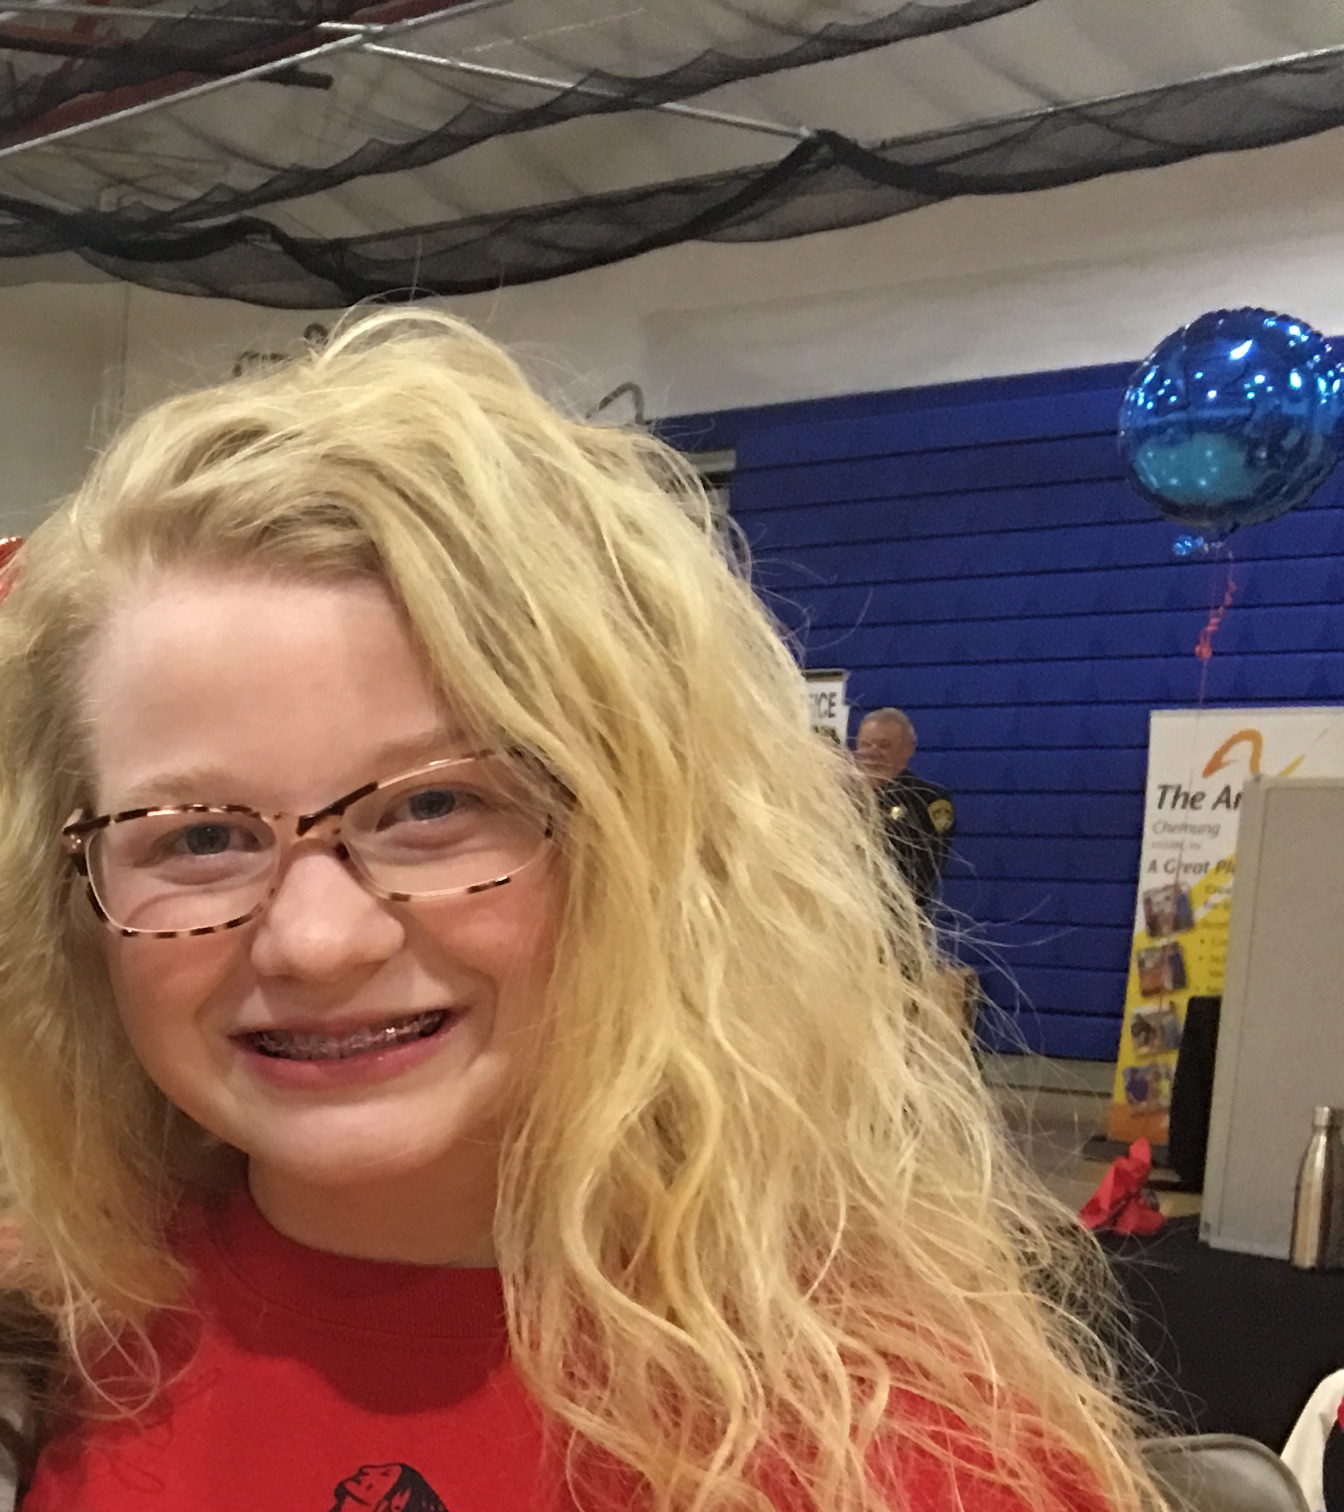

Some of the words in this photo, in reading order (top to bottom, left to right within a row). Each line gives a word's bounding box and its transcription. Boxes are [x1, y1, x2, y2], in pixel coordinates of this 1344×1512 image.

[1156, 783, 1206, 812] The
[1211, 783, 1243, 812] Ar
[1151, 820, 1221, 840] Chemung
[1146, 859, 1159, 875] A
[1163, 858, 1211, 876] Great
